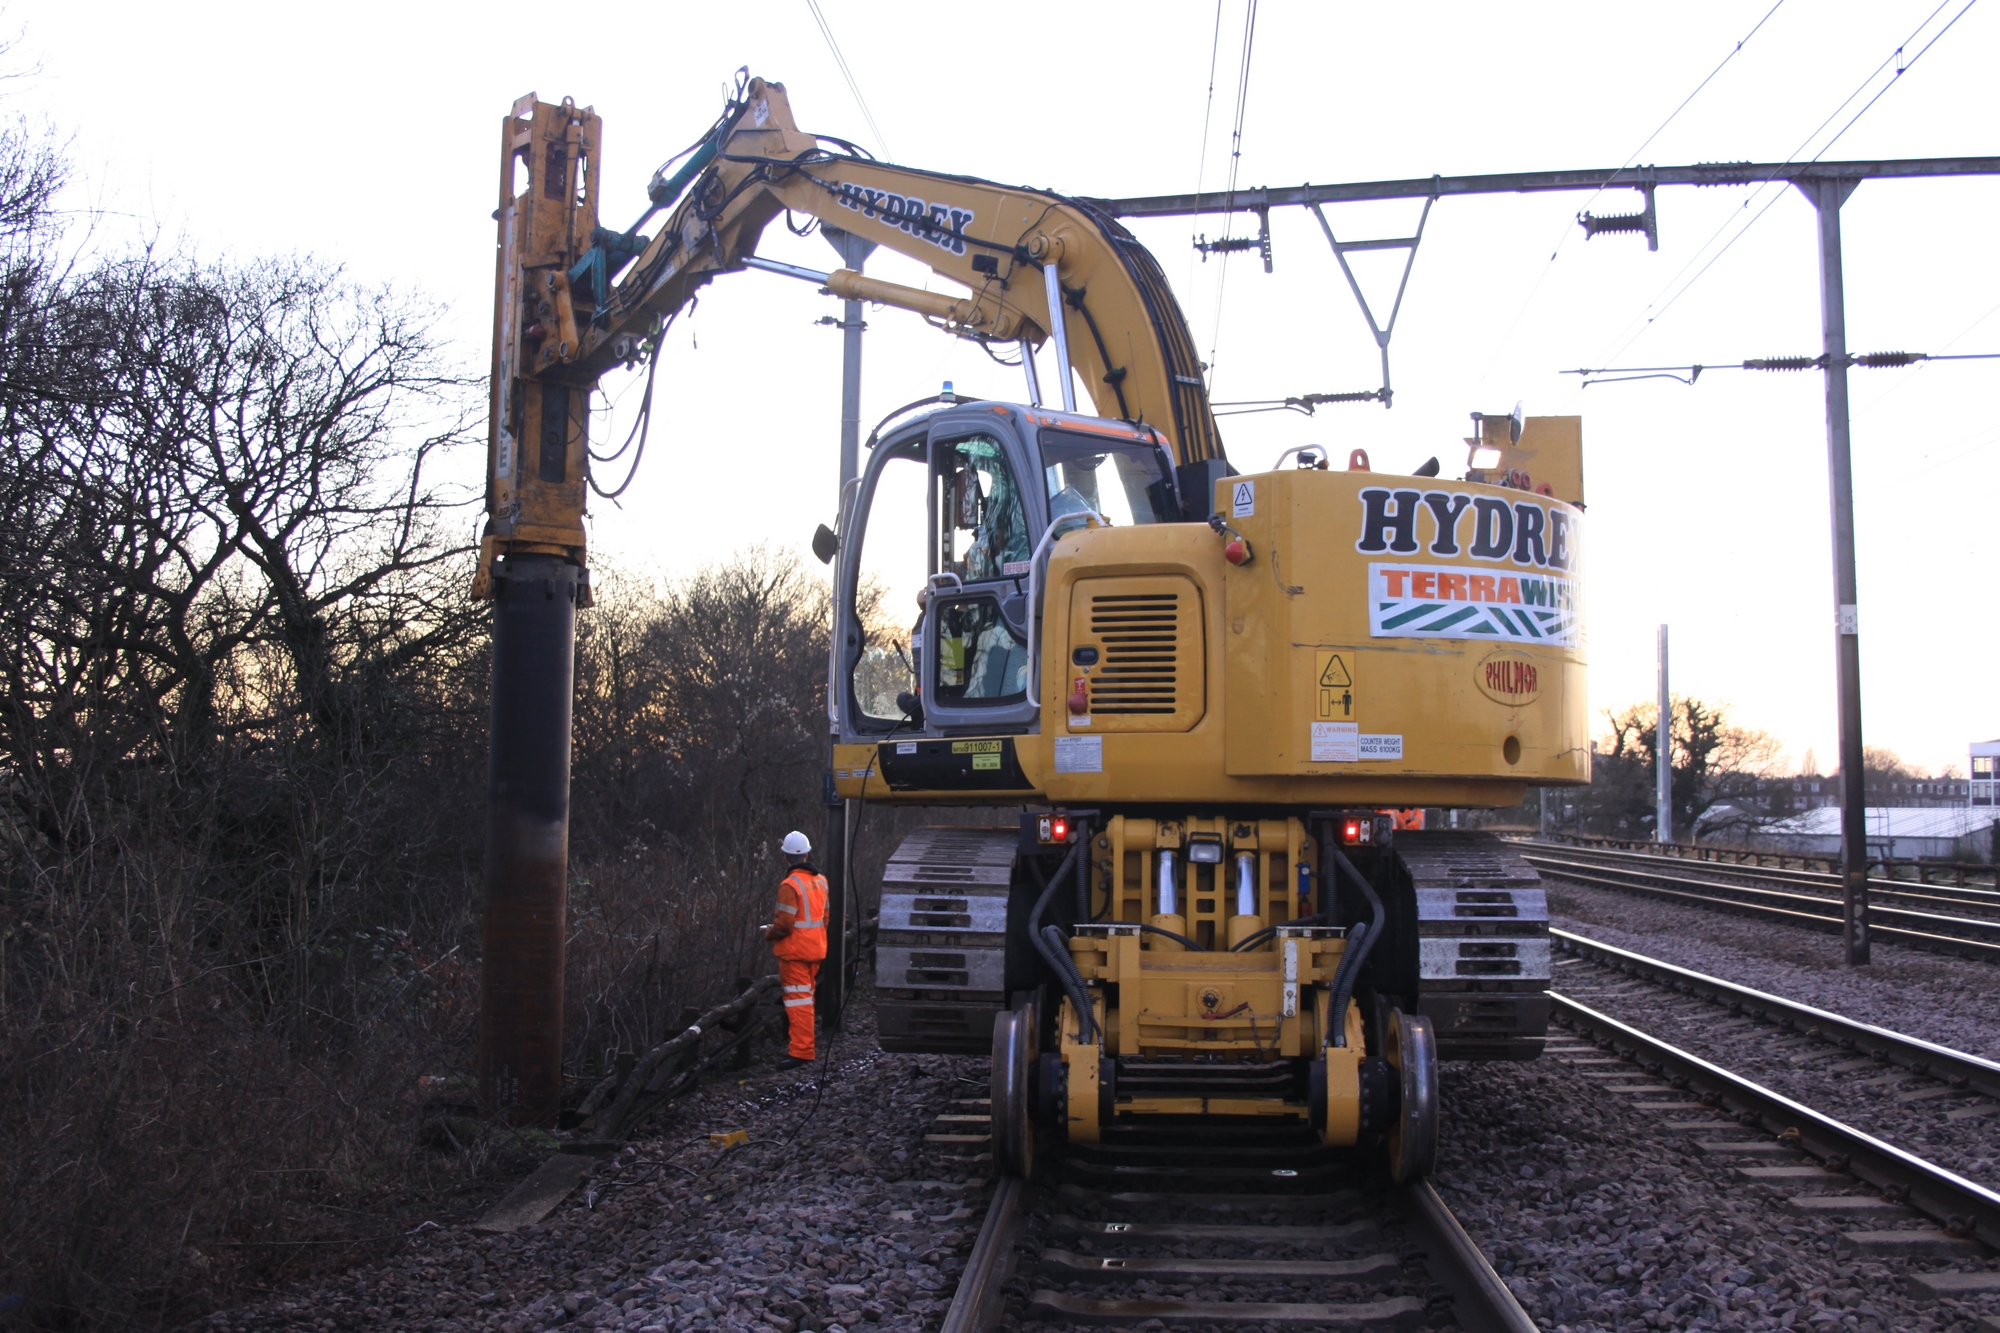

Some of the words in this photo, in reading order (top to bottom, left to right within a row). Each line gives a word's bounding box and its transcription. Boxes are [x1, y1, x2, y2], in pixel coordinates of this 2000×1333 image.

[839, 184, 973, 255] HYDREX
[1486, 661, 1538, 694] PHILMOR
[965, 741, 1000, 752] 911007-1
[1360, 737, 1382, 745] COUNTER
[1360, 745, 1378, 753] MASS
